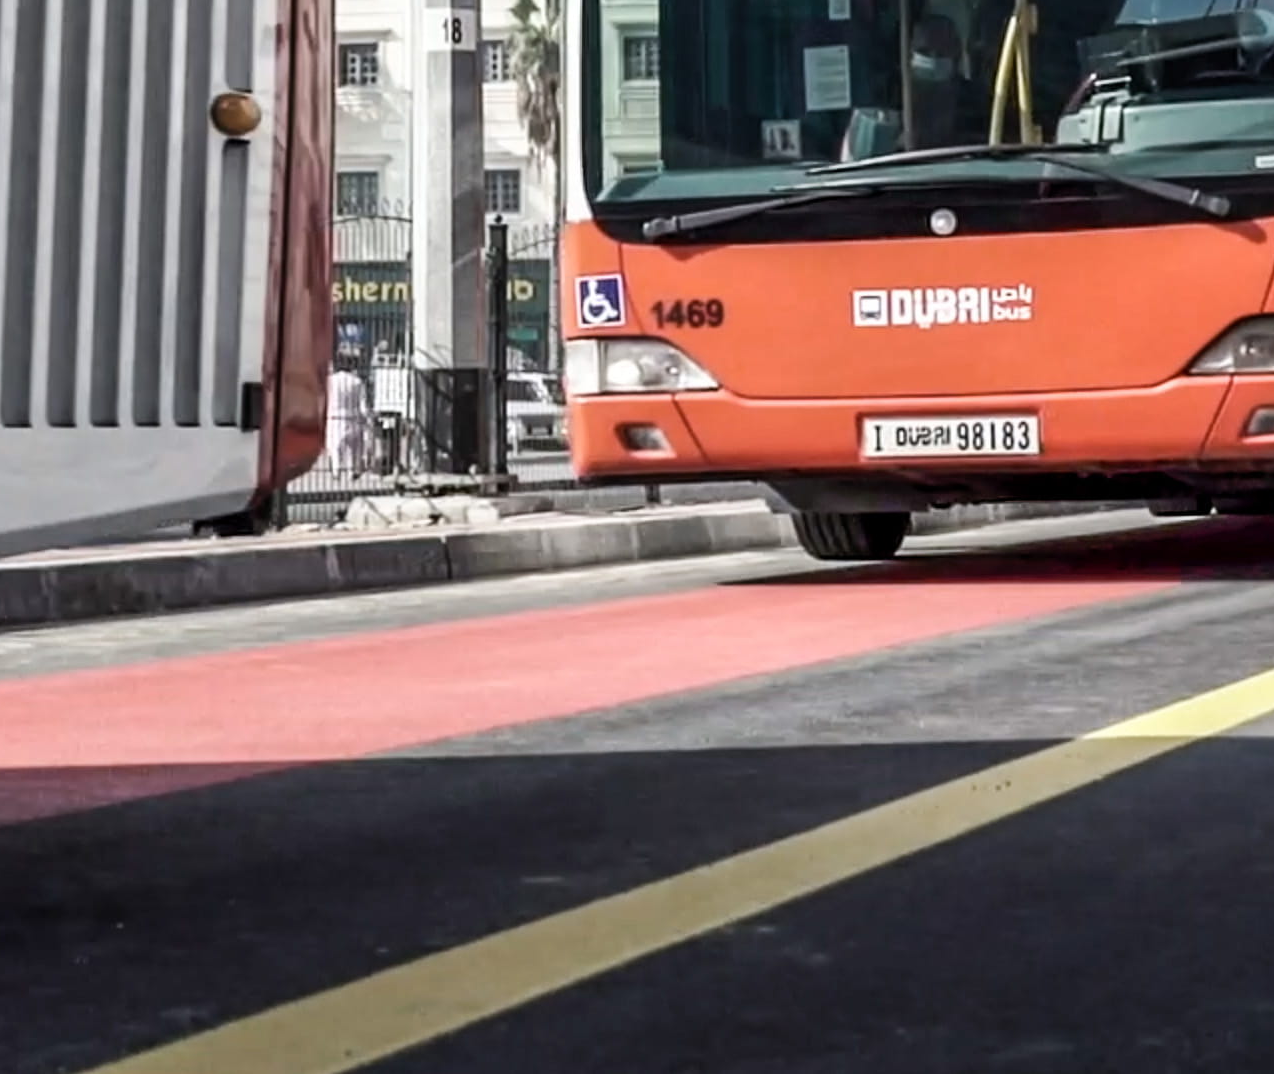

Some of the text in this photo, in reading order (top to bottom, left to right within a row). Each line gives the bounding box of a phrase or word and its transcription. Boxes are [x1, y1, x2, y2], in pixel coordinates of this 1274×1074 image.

[441, 17, 463, 45] 18
[890, 286, 989, 328] DUBAI
[991, 283, 1033, 304] باص
[651, 299, 724, 329] 1469
[991, 304, 1032, 321] bus
[956, 421, 1031, 451] 98183
